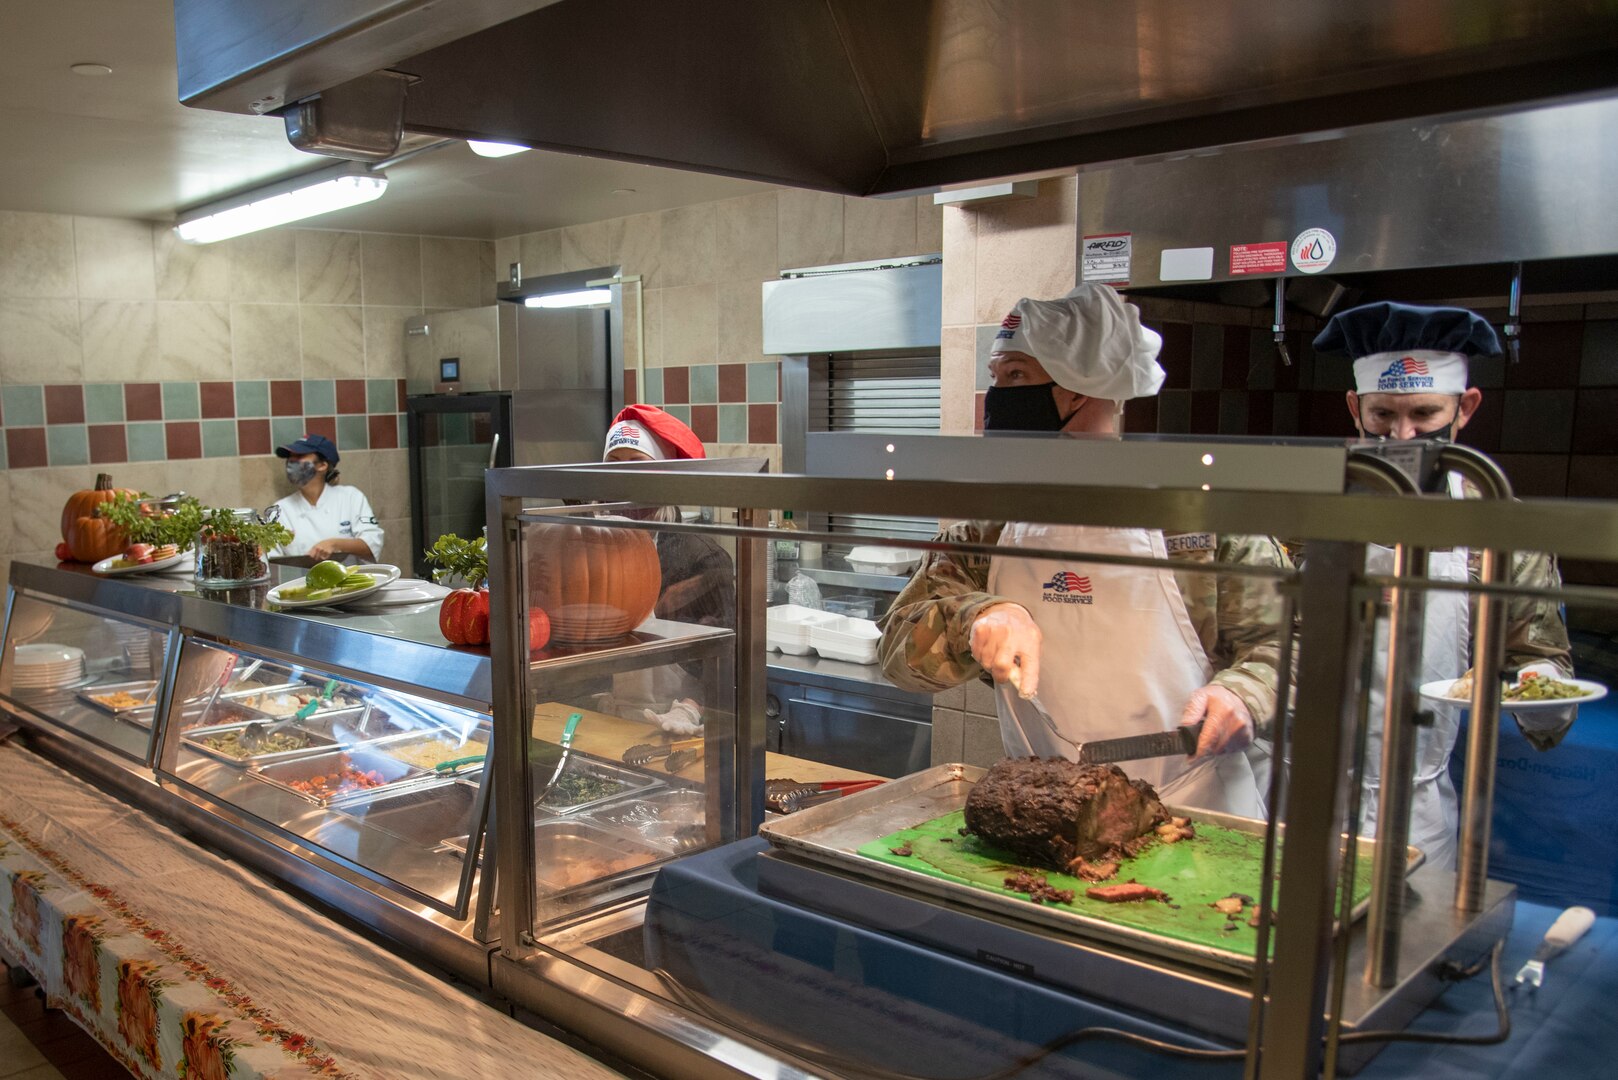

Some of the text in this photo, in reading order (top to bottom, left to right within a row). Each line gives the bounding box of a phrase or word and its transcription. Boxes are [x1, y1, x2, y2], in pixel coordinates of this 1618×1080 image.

[1378, 382, 1398, 390] FOOD
[1166, 534, 1211, 551] CE FORCE
[1063, 597, 1093, 605] SERVICE
